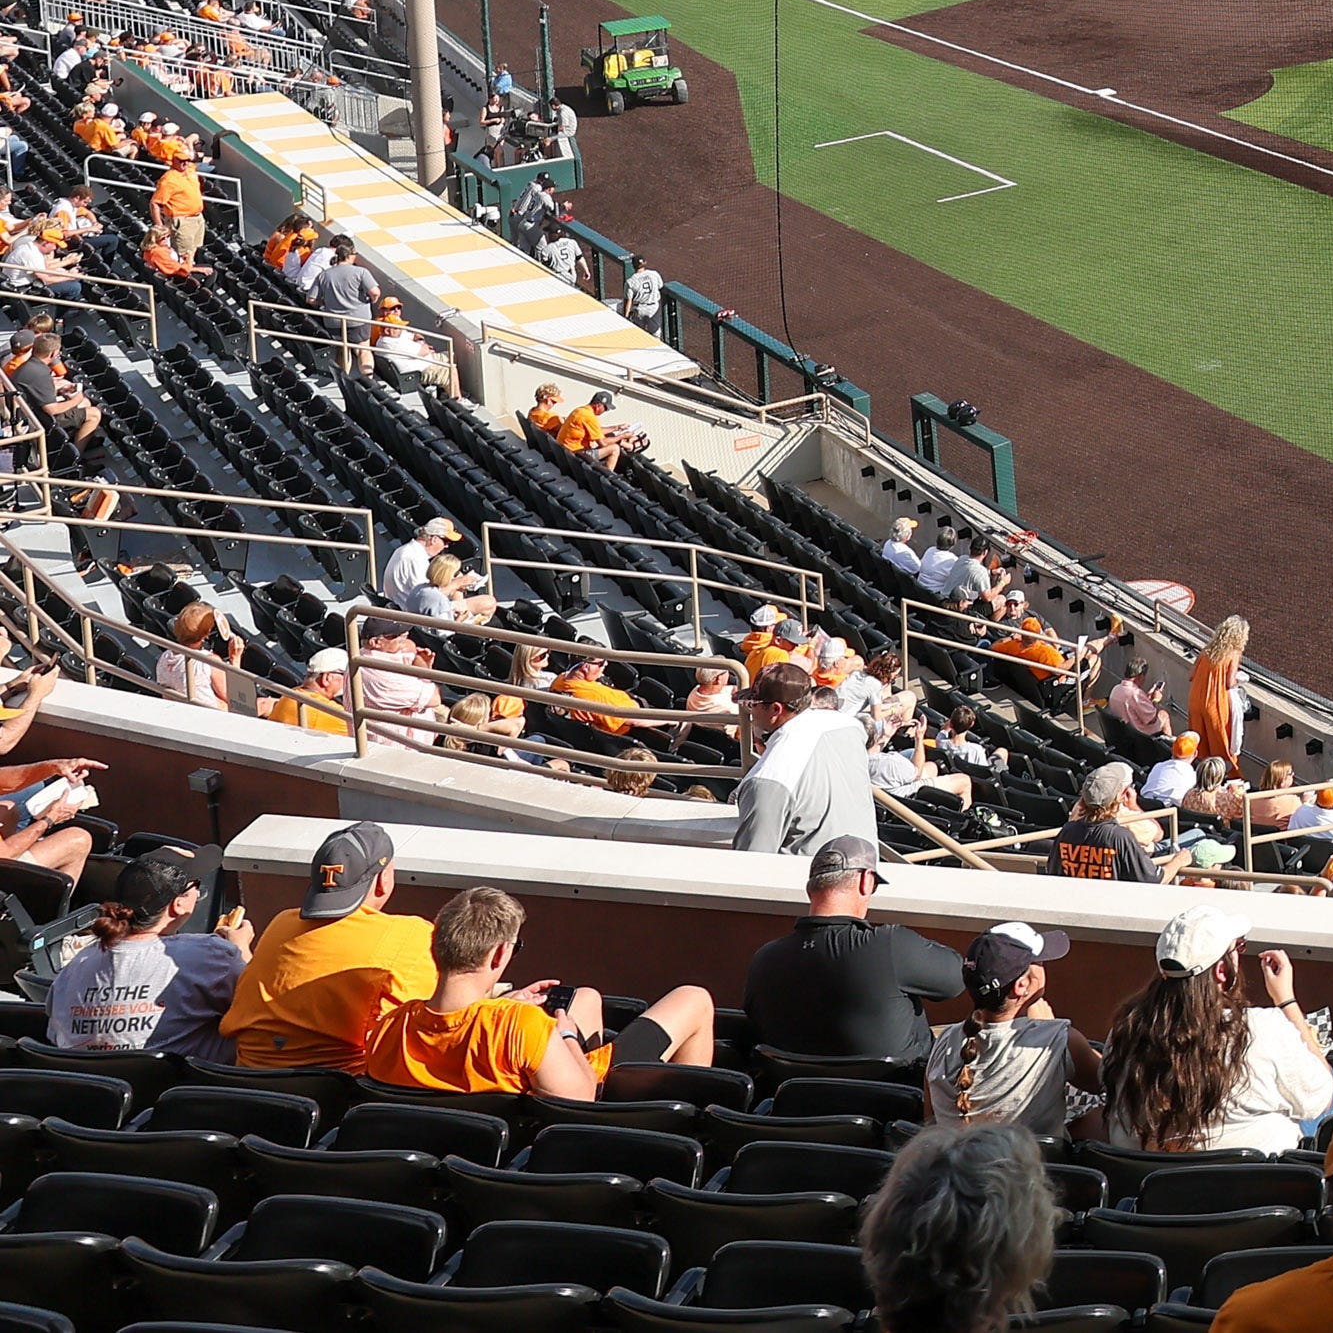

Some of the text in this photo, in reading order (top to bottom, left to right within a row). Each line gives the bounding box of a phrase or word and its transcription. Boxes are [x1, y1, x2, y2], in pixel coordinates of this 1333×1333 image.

[559, 247, 569, 261] 5
[642, 281, 653, 294] 9
[1059, 842, 1118, 866] EVENT
[320, 864, 344, 887] T
[1061, 860, 1112, 881] STAFF
[83, 984, 150, 1003] IT'S THE
[70, 1001, 166, 1017] TENNESSEE VOLS
[71, 1015, 155, 1035] NETWORK
